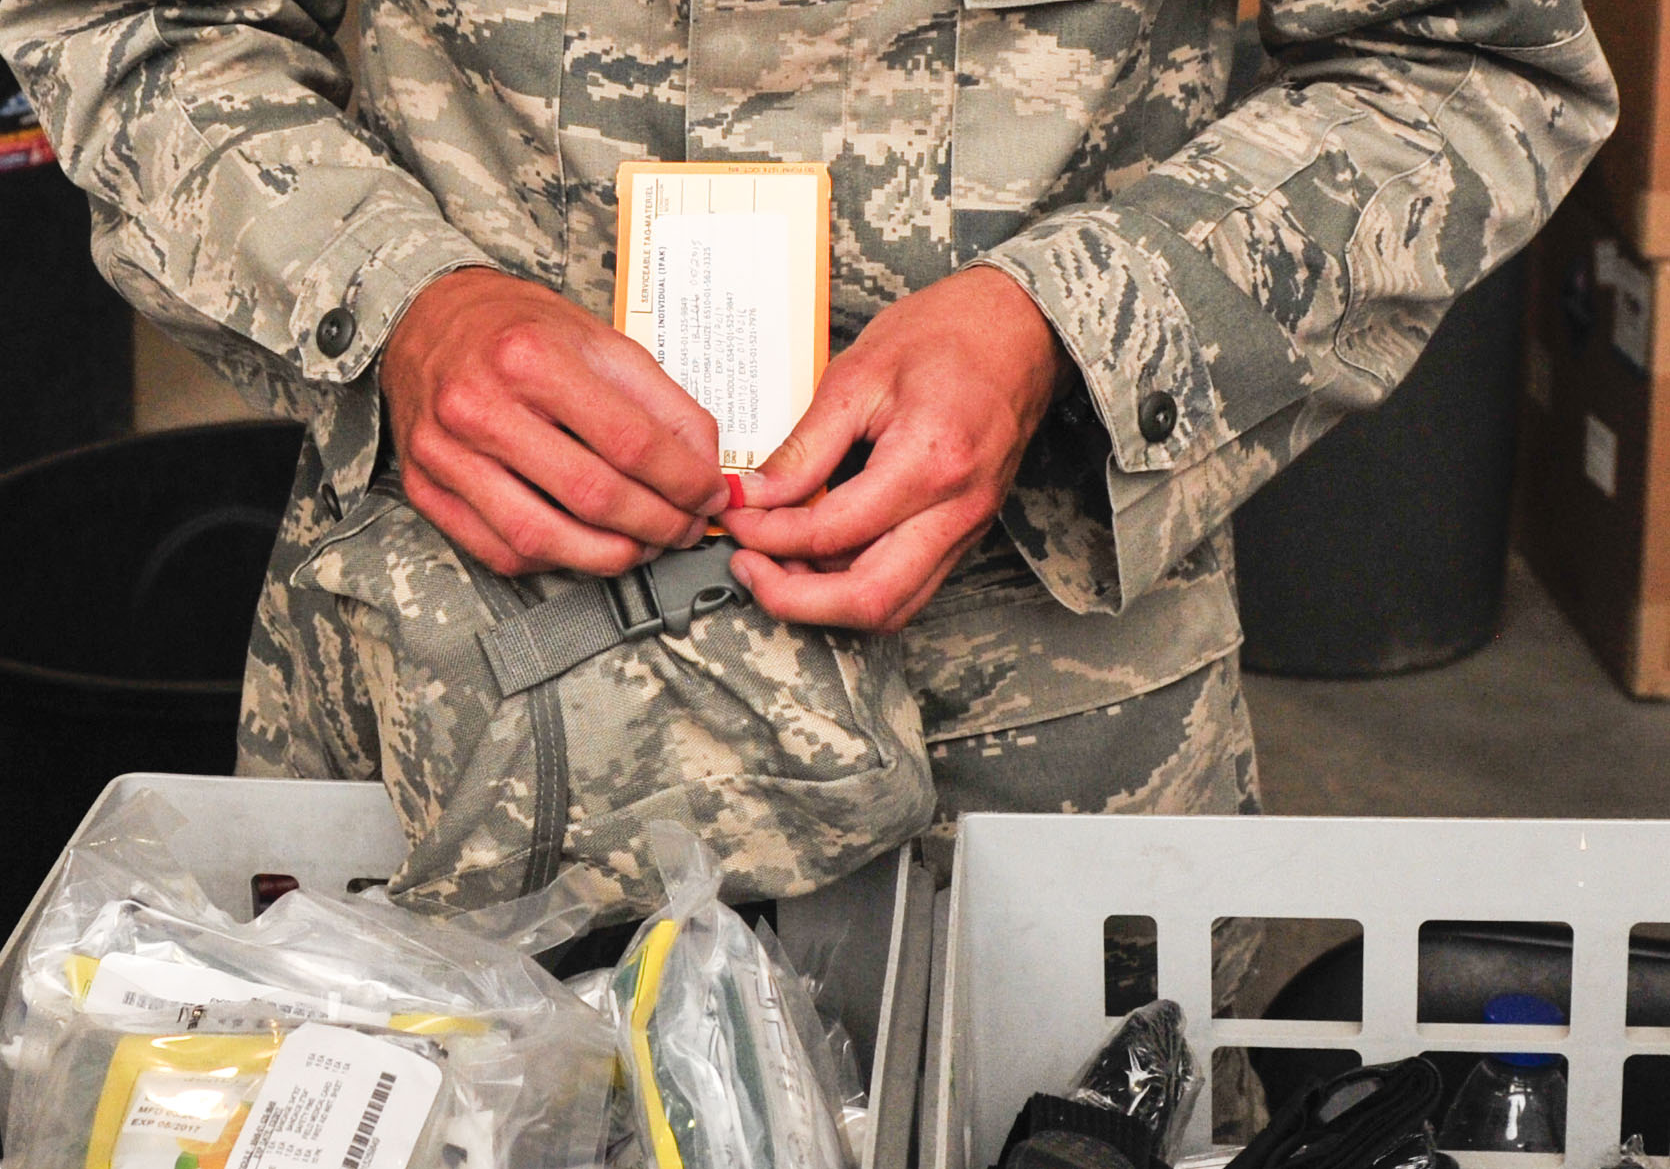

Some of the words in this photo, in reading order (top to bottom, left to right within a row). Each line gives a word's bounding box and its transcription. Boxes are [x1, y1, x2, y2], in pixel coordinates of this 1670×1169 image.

[641, 249, 651, 304] SERVICEABLE
[658, 277, 666, 329] INDIVIDUAL
[658, 331, 666, 348] KIT,
[703, 352, 711, 383] COMBAT
[727, 401, 735, 433] TRAUMA
[130, 1118, 155, 1127] EXP
